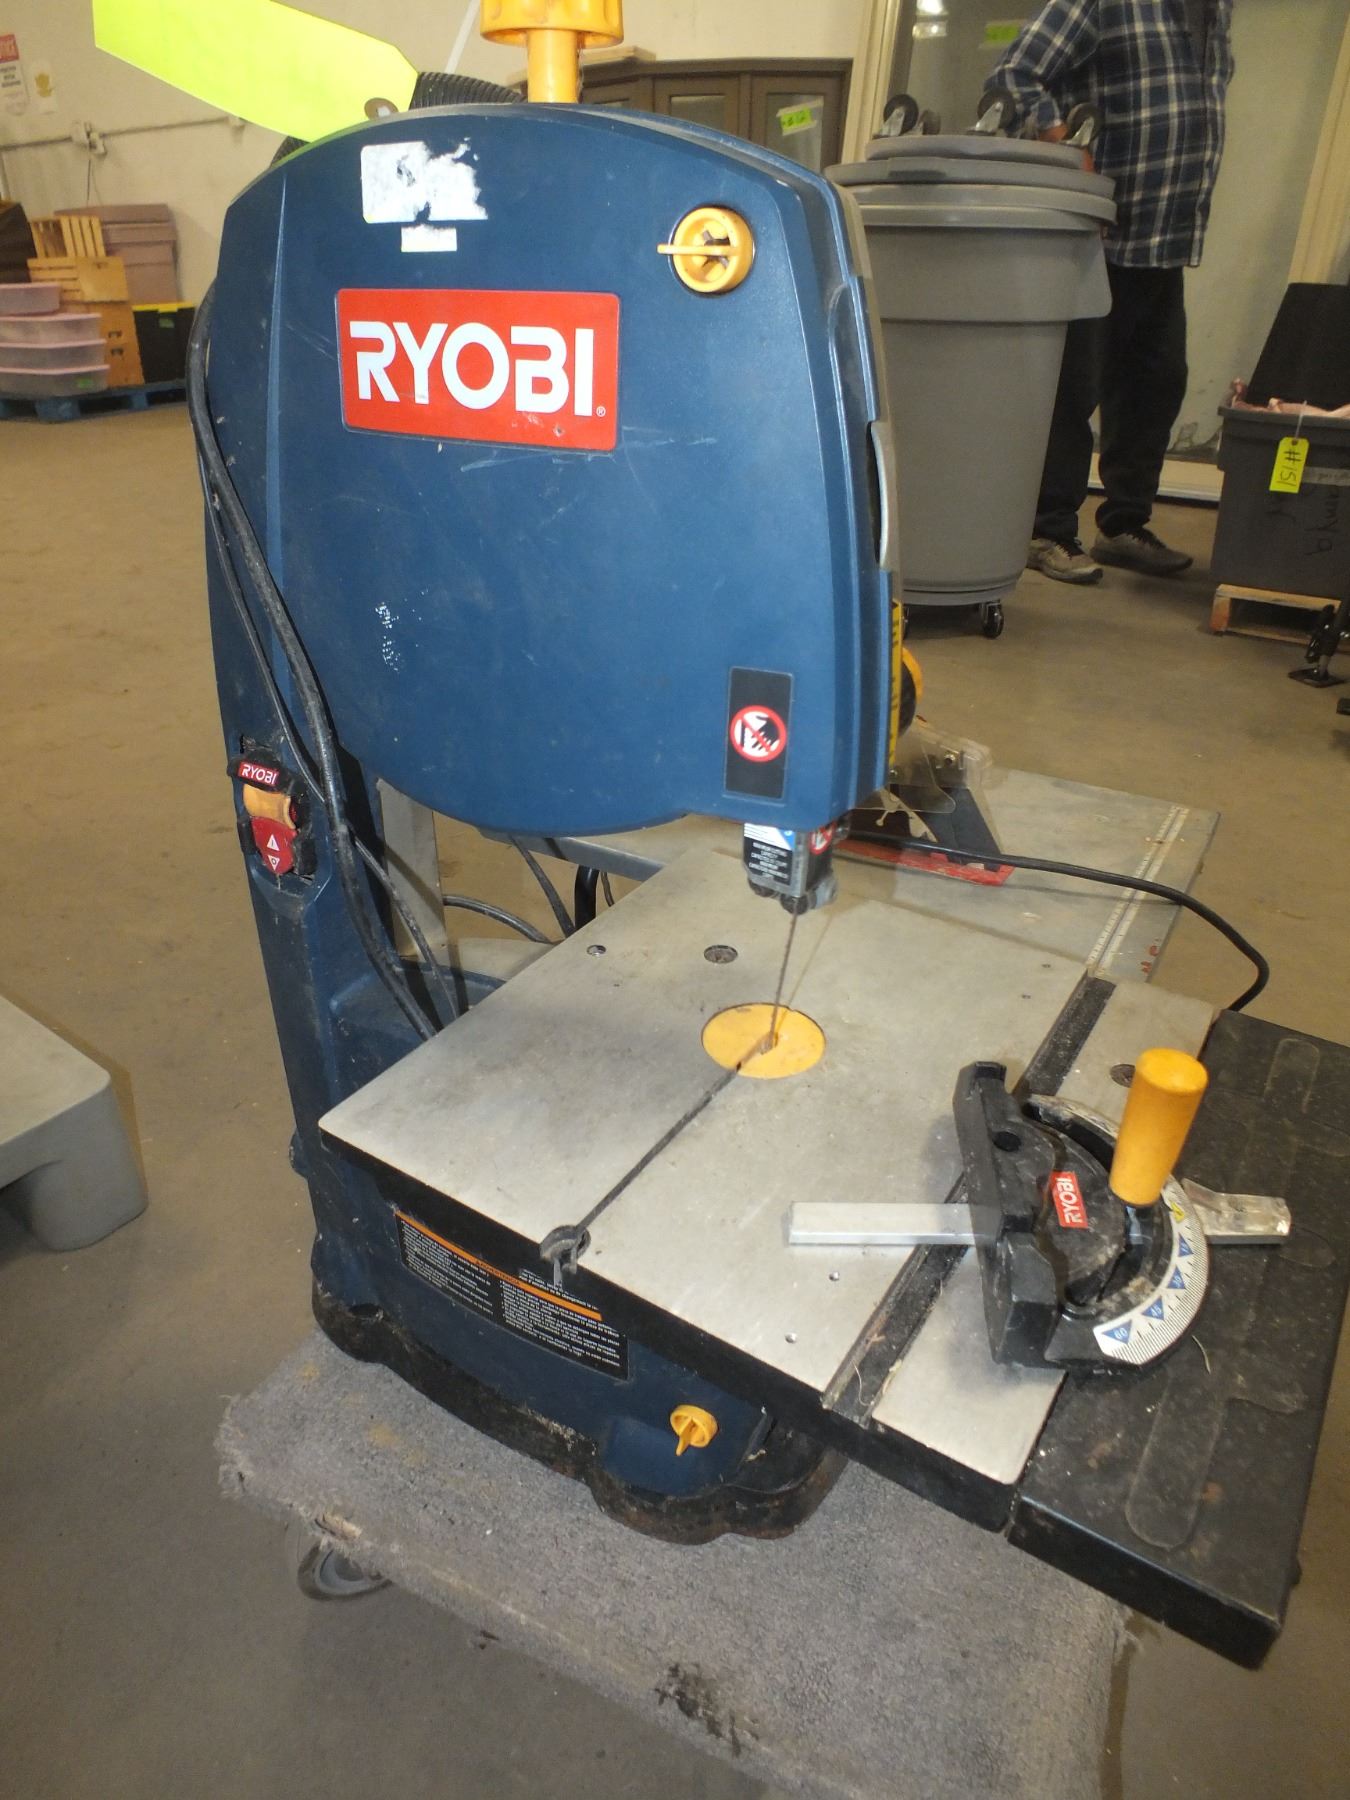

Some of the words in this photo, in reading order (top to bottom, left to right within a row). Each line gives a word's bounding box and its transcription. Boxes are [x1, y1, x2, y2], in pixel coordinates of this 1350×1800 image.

[241, 764, 277, 785] RYOBI
[1055, 1177, 1084, 1224] RYOBI
[1150, 1303, 1162, 1318] 45
[1113, 1327, 1129, 1340] 60
